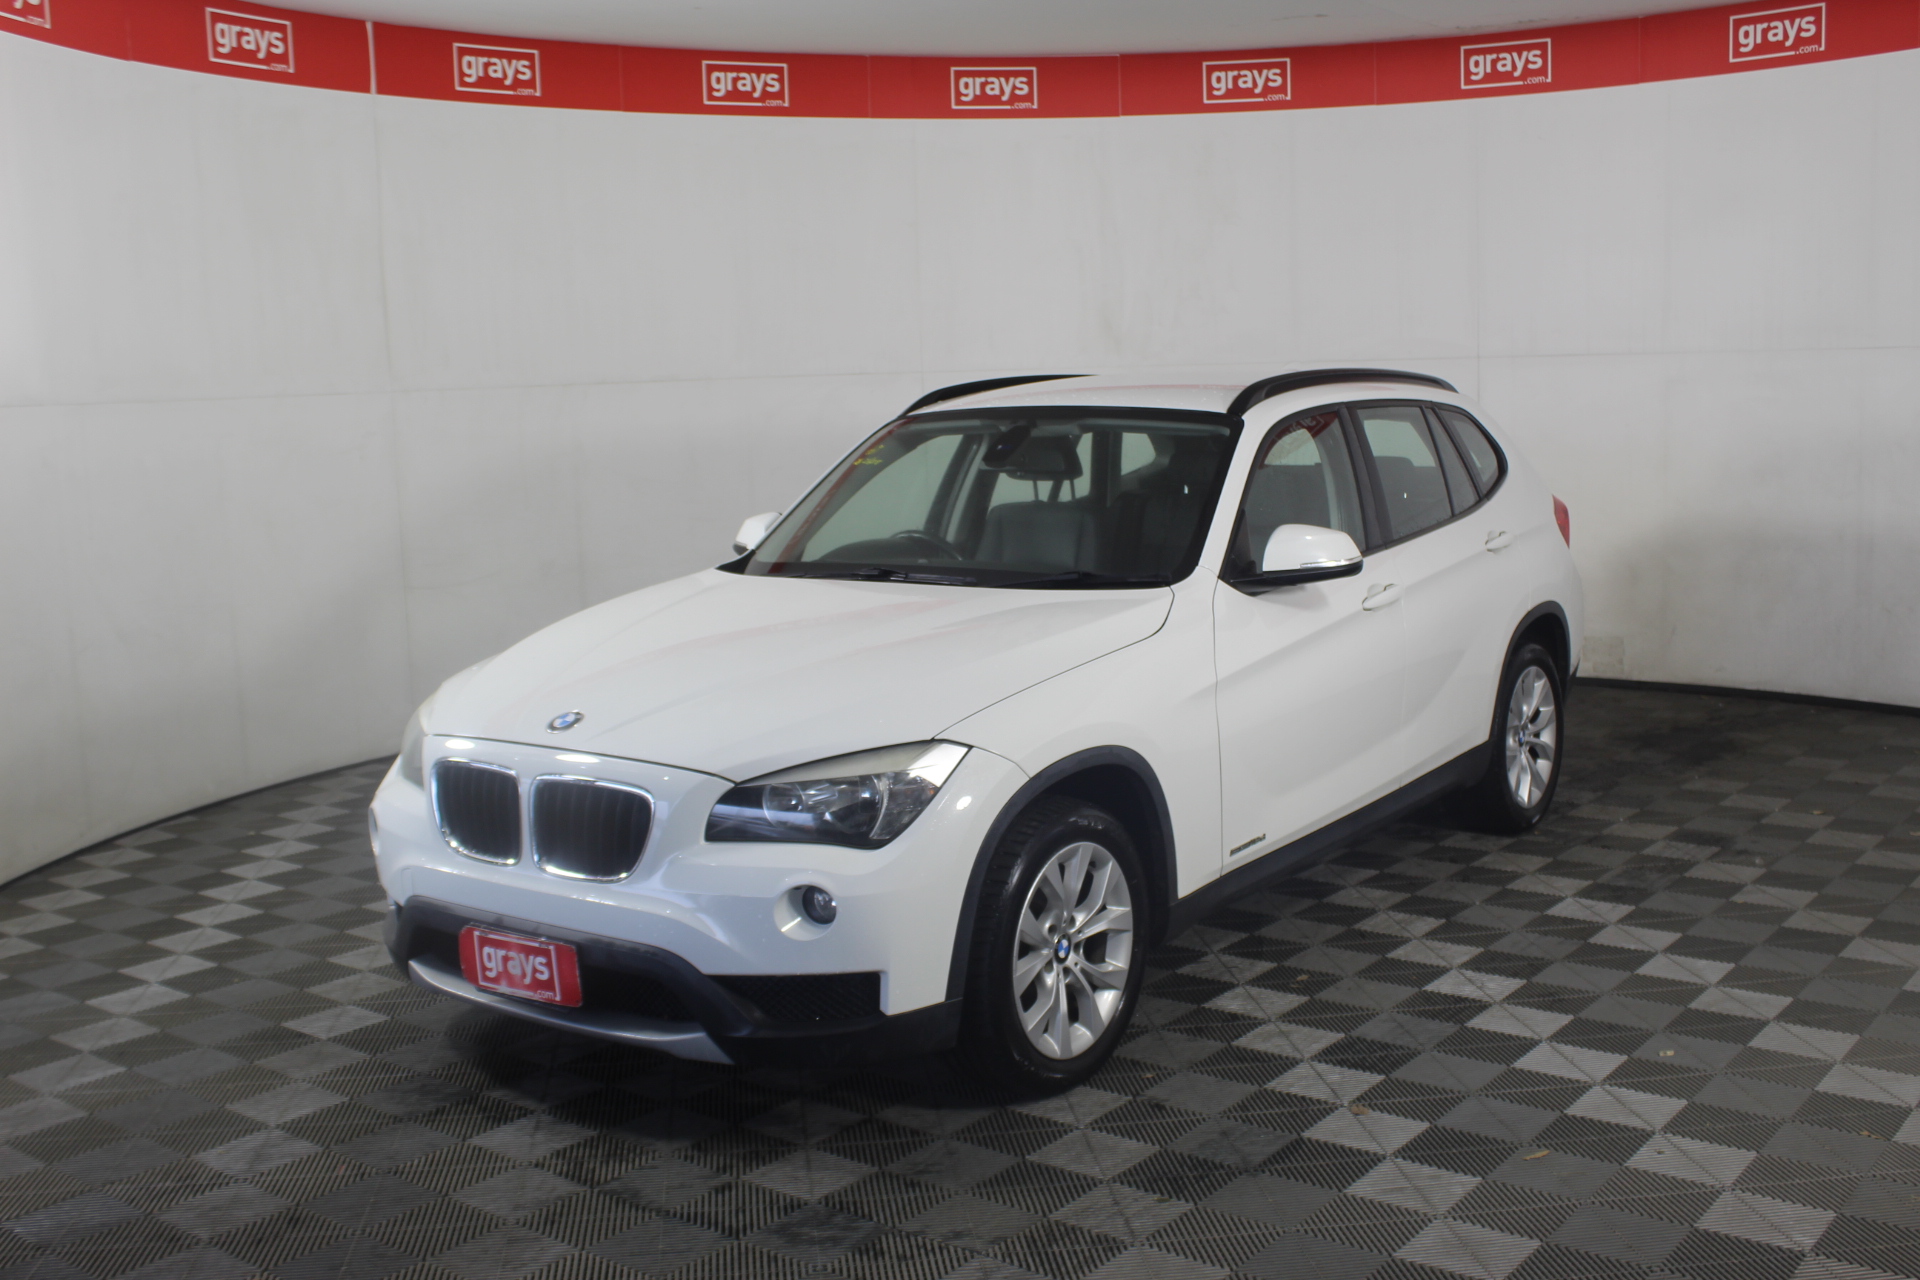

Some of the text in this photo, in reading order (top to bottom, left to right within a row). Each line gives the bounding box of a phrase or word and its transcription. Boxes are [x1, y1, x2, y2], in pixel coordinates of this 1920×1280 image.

[214, 22, 286, 59] grays
[1738, 15, 1817, 53] grays
[1796, 44, 1819, 55] .com
[461, 54, 532, 86] grays
[1468, 49, 1543, 81] grays
[1523, 75, 1546, 85] .com
[710, 71, 781, 98] grays
[959, 76, 1029, 102] grays
[1211, 68, 1283, 96] grays
[482, 946, 551, 985] grays
